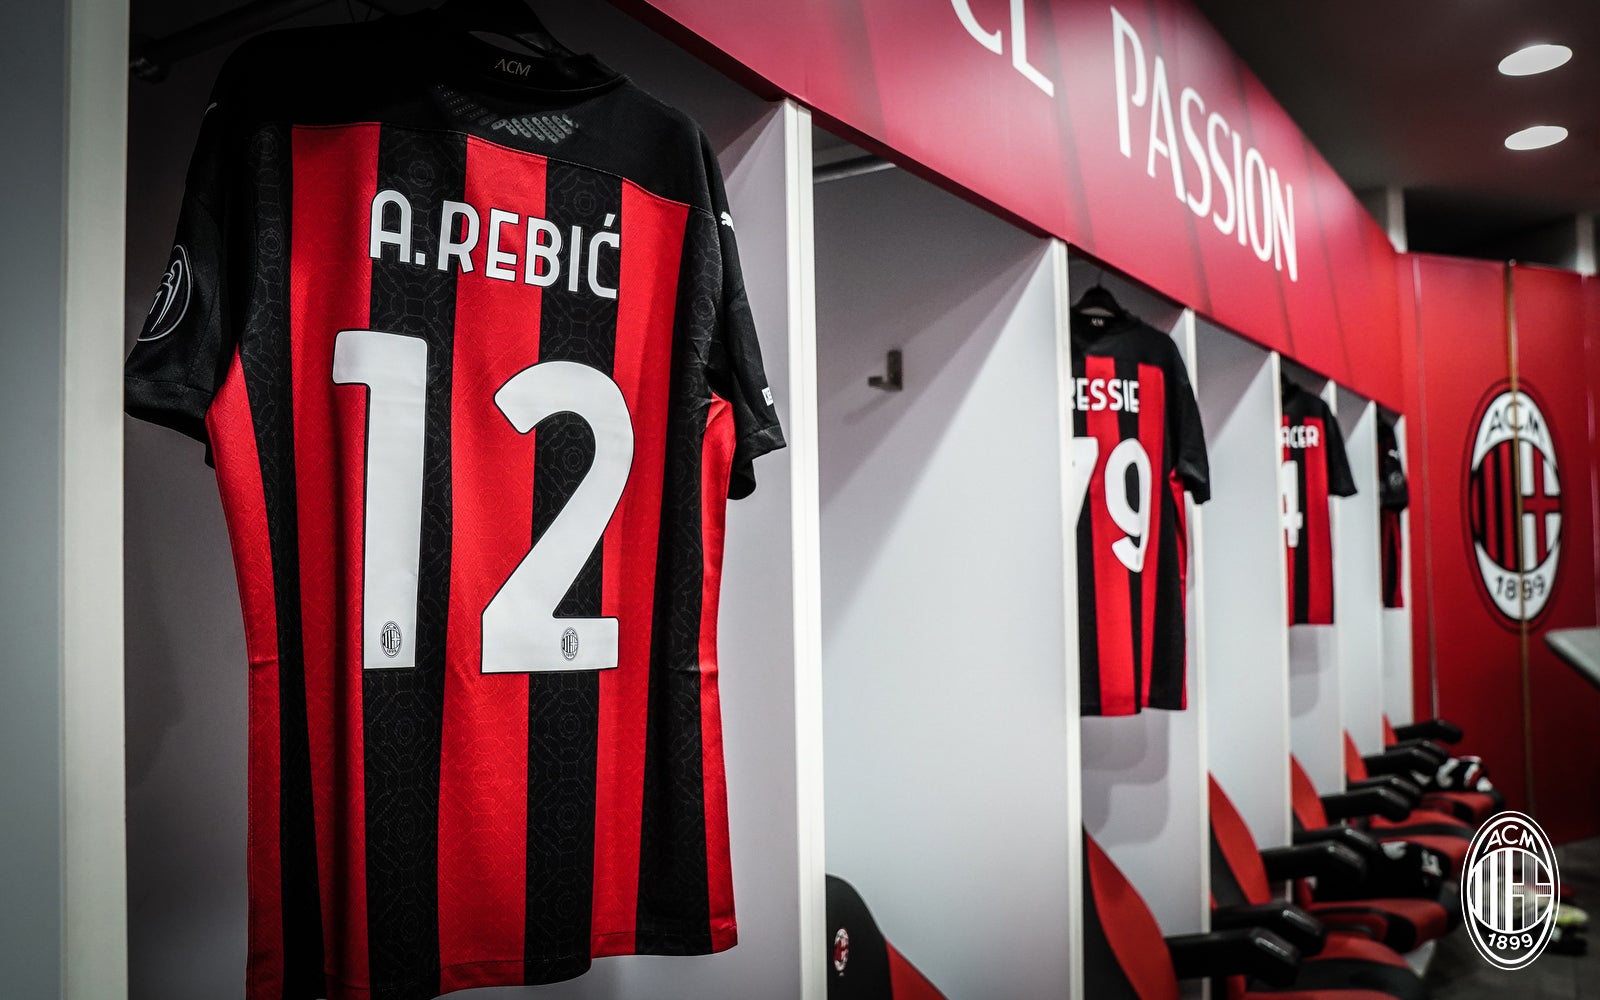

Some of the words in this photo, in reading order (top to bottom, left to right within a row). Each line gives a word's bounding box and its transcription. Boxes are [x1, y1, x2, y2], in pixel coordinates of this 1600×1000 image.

[494, 58, 531, 77] ACM
[1110, 5, 1297, 283] PASSION
[1072, 377, 1139, 413] ESSIE
[1486, 402, 1545, 443] ACM
[333, 330, 634, 673] 12
[1496, 576, 1546, 600] 1899
